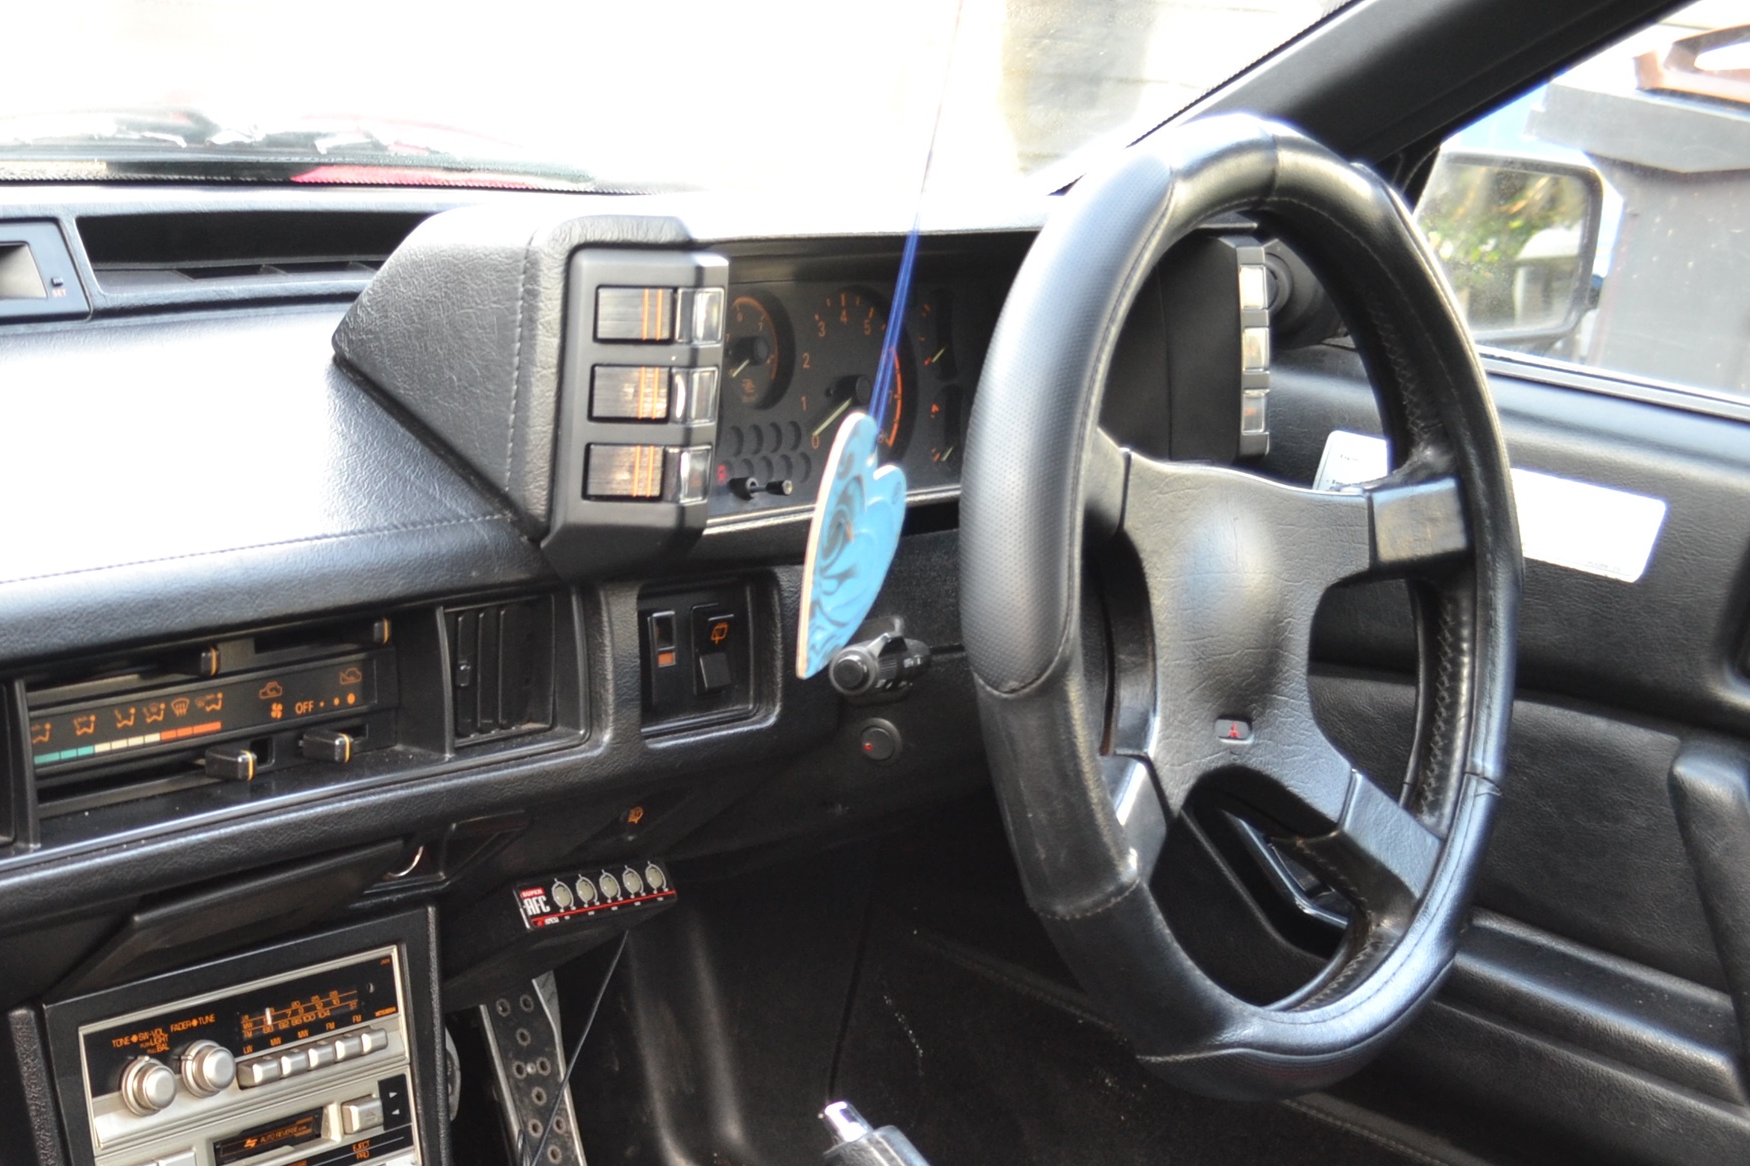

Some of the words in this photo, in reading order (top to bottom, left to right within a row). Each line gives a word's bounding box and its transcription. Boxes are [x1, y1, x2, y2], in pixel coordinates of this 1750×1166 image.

[53, 289, 66, 297] SET
[841, 309, 847, 324] 4
[818, 321, 826, 337] 3
[863, 319, 871, 335] 5
[803, 353, 810, 368] 2
[801, 396, 807, 411] 1
[812, 435, 820, 449] 0
[295, 700, 314, 714] OFF
[523, 895, 551, 915] AFC
[171, 1020, 191, 1032] FADER
[198, 1014, 216, 1025] TUNE
[112, 1036, 131, 1048] TONE
[353, 1140, 370, 1152] EJECT
